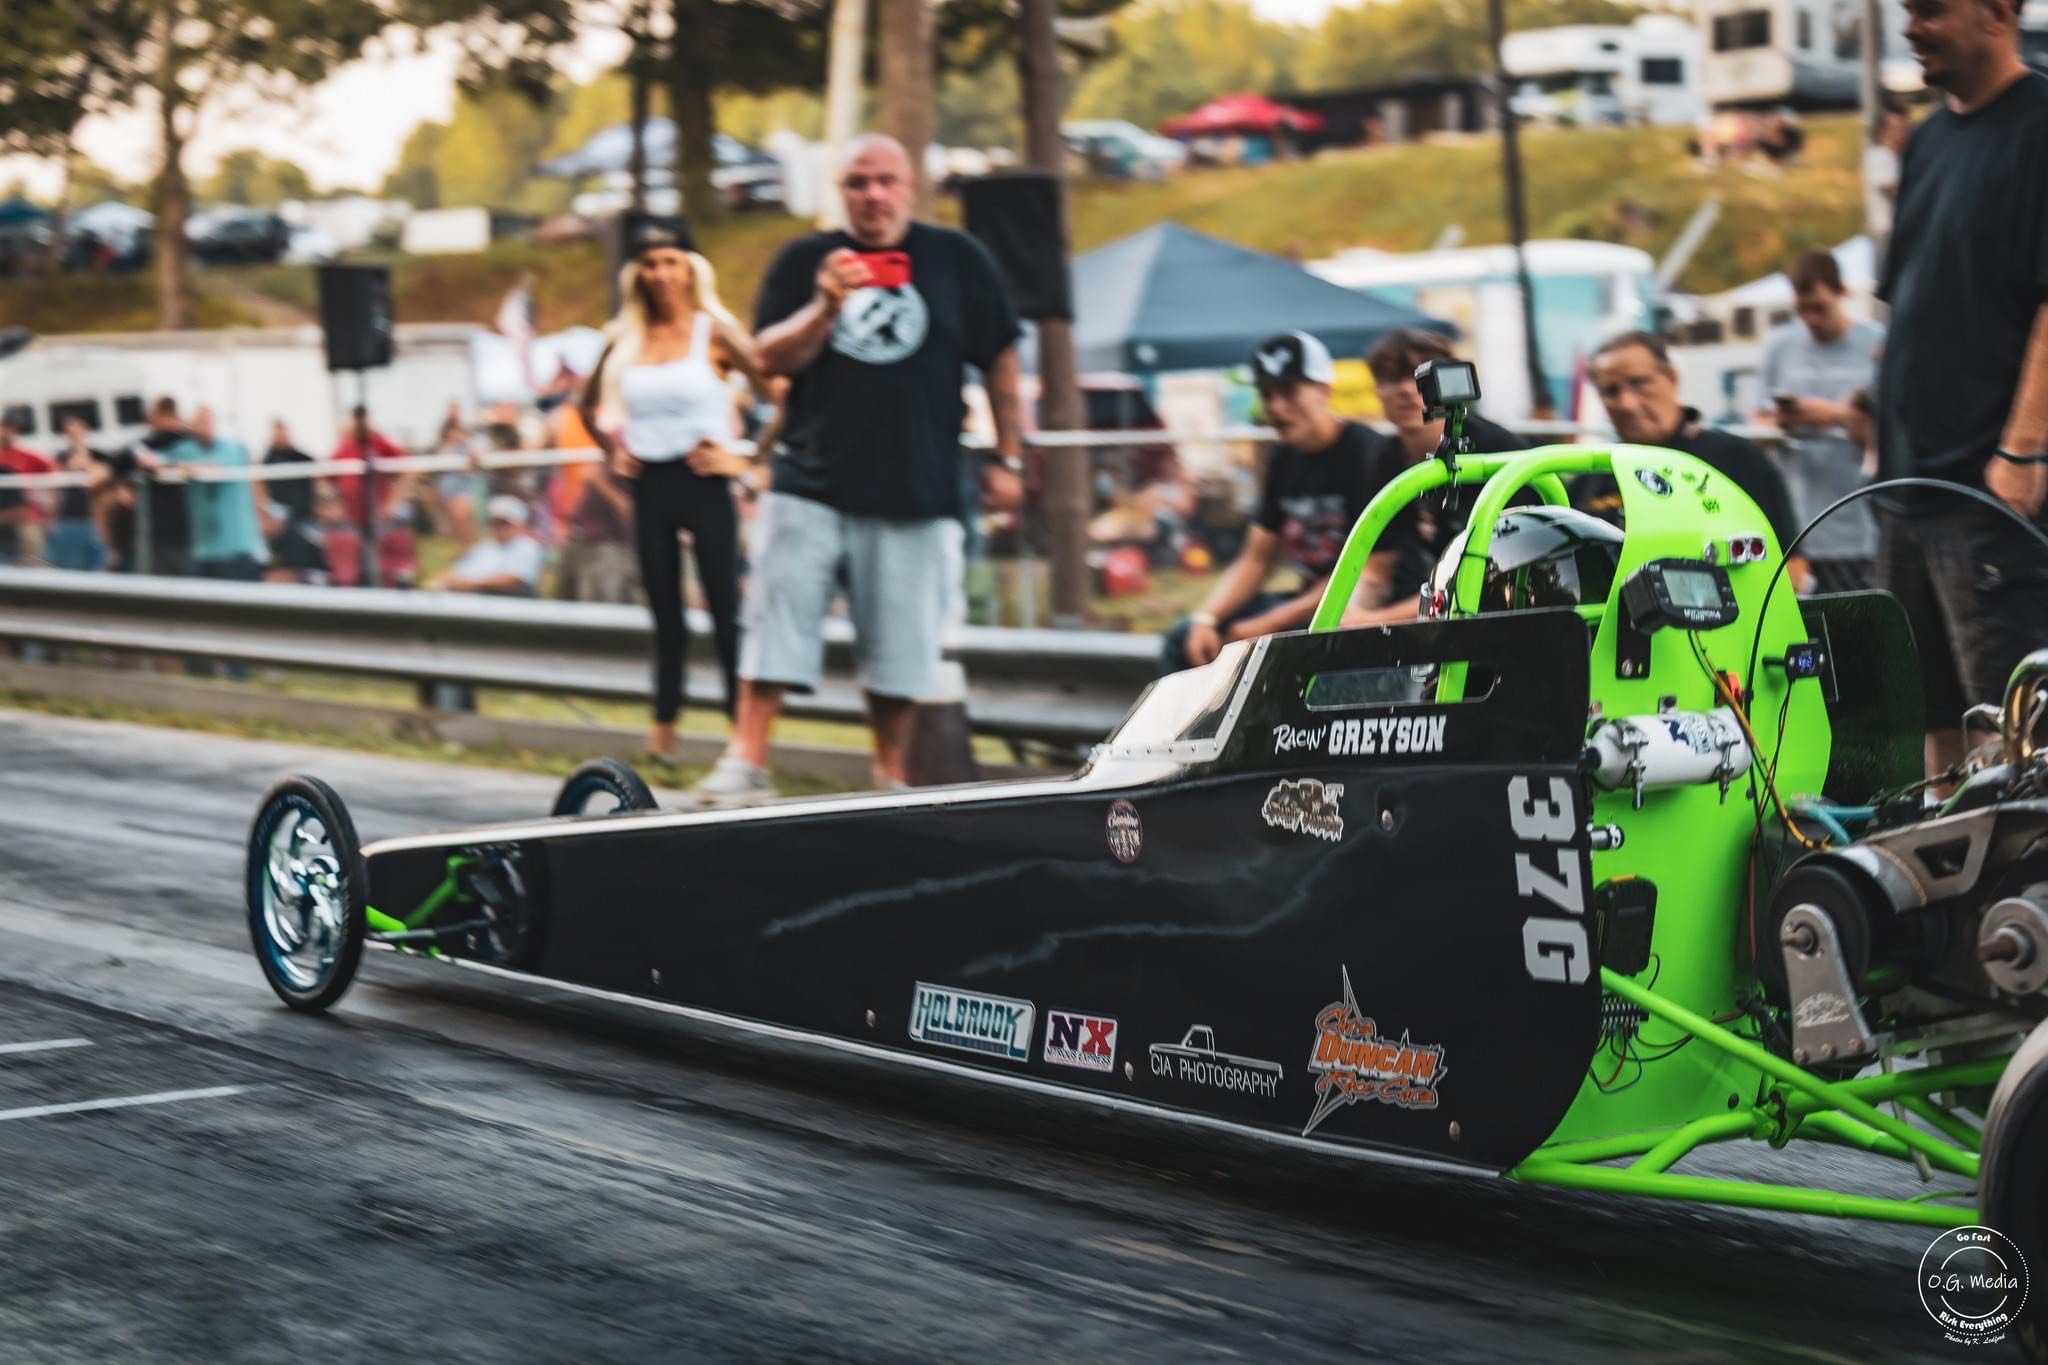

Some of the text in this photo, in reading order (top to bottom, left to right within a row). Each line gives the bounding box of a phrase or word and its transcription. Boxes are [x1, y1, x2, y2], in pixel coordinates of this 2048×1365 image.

[1328, 715, 1447, 756] GREYSON
[1507, 775, 1591, 985] 37G
[914, 990, 1026, 1053] HOLBROOK
[1048, 1014, 1115, 1056] NX
[1150, 1054, 1278, 1098] CIA PHOTOGRAPHY
[1316, 1032, 1439, 1080] DUNCAN
